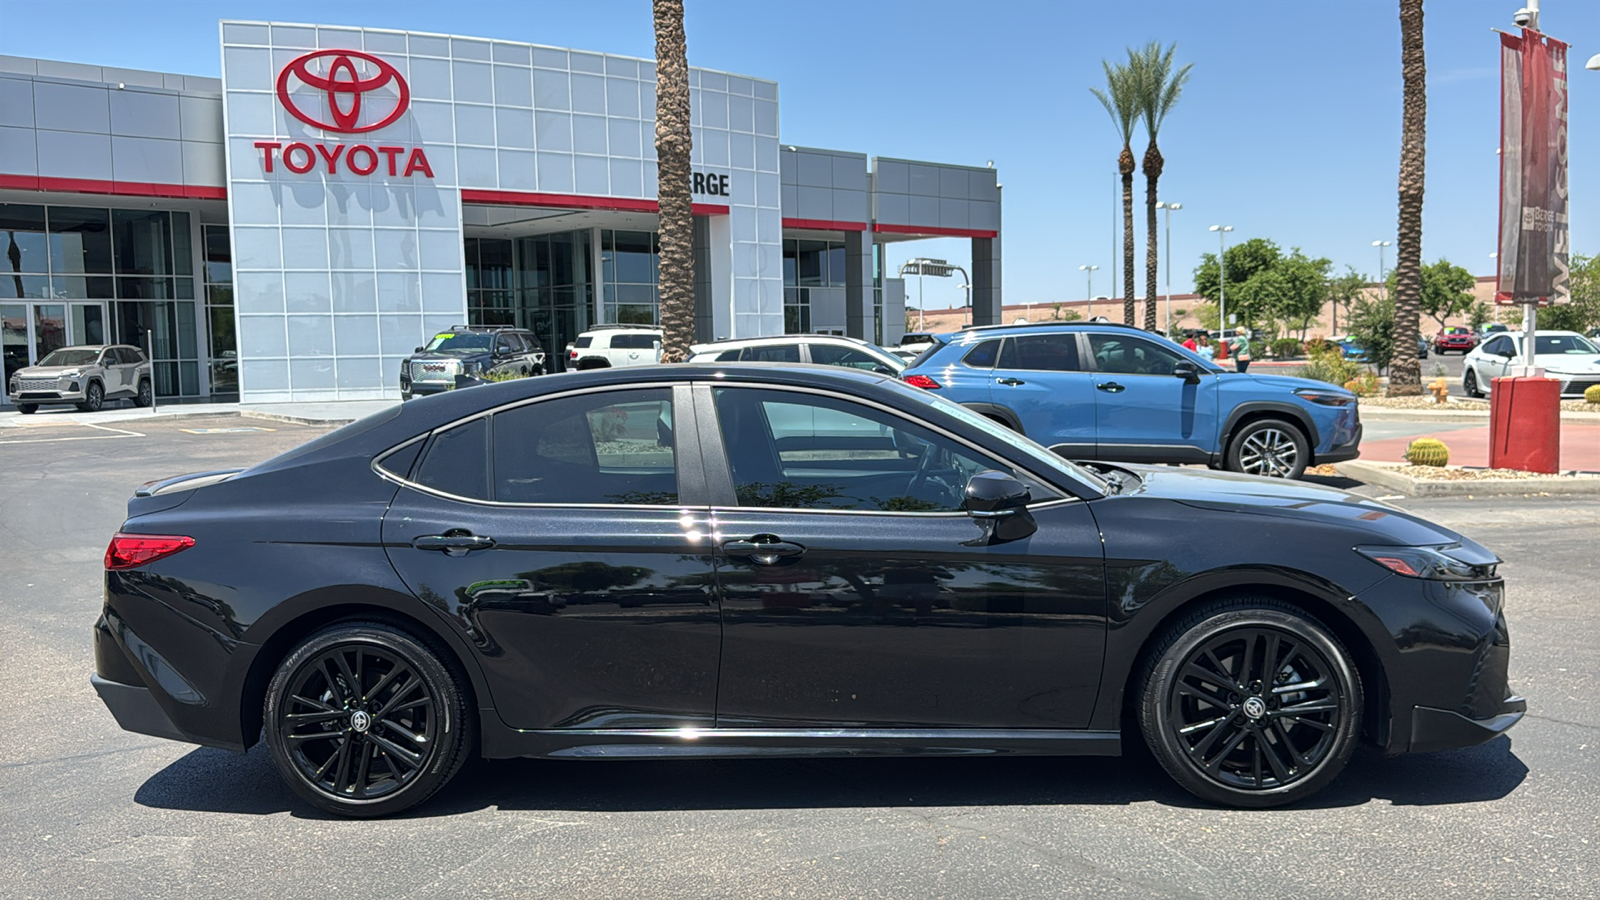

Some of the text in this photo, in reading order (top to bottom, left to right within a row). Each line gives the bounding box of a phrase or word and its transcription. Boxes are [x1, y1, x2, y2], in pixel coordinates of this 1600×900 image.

[254, 141, 435, 178] TOYOTA
[689, 172, 730, 197] RGE
[1551, 46, 1571, 304] WELCOME
[1534, 206, 1554, 222] BERGE
[1534, 222, 1554, 232] TOYOTA
